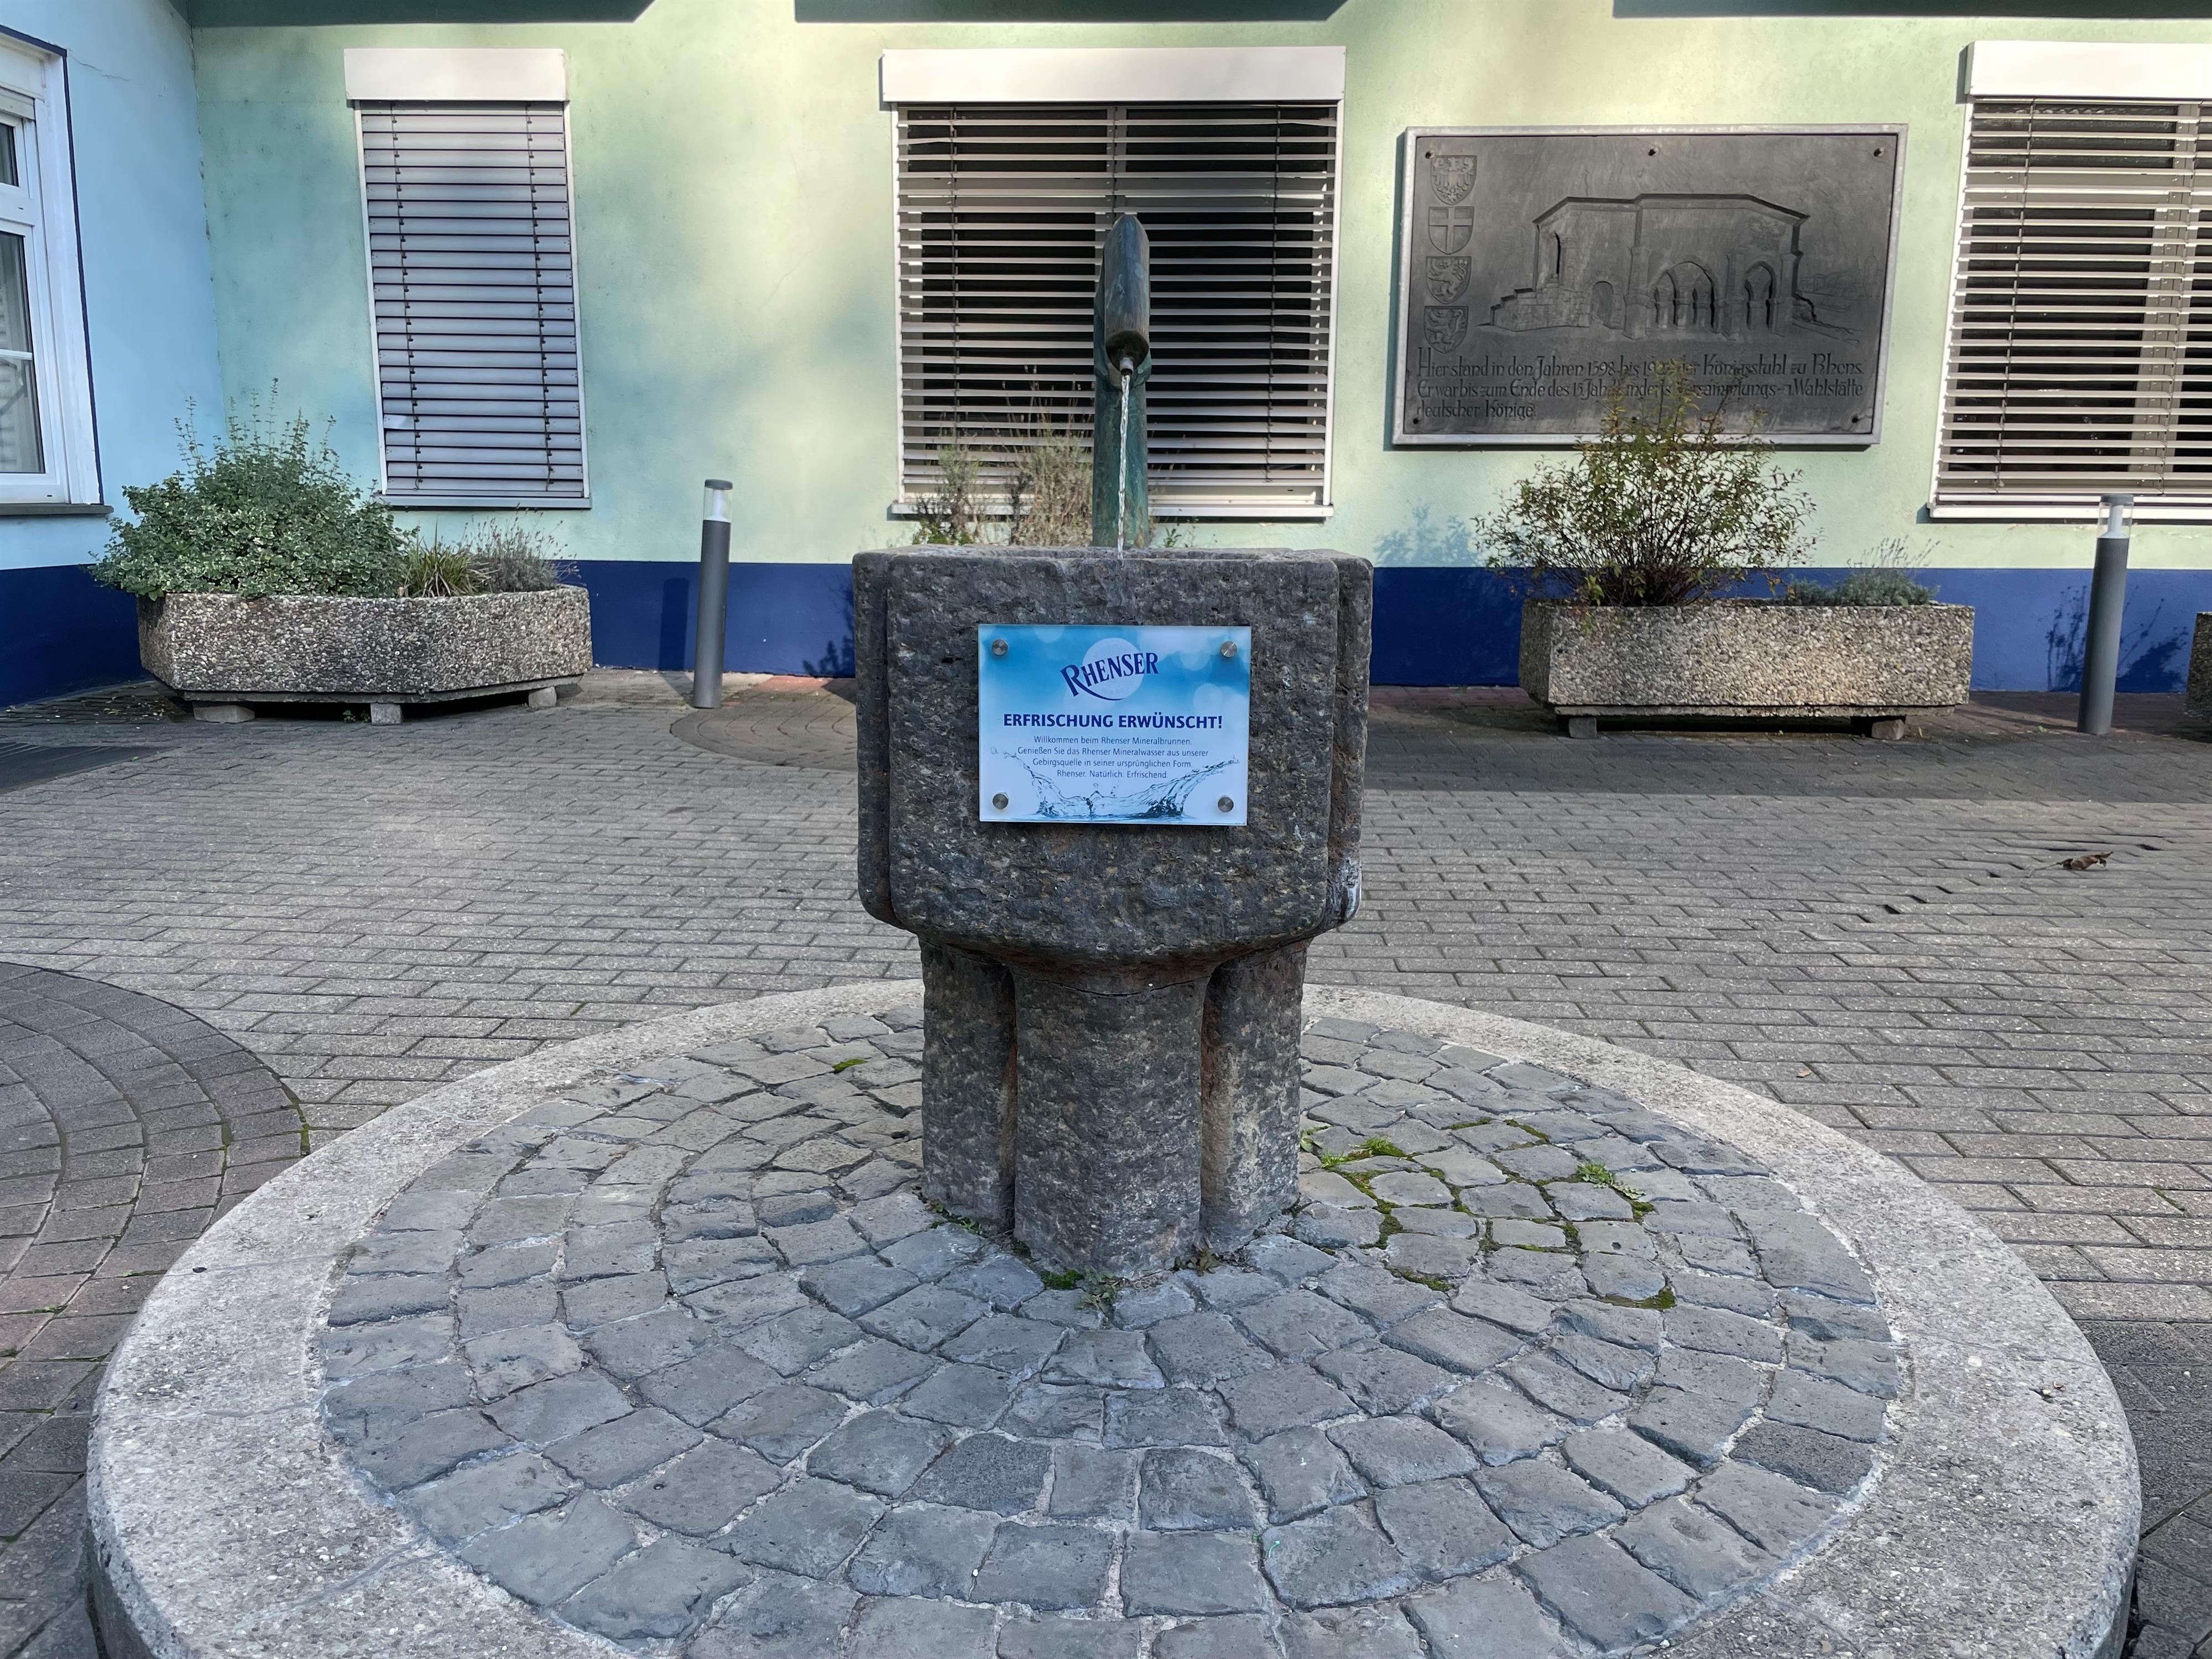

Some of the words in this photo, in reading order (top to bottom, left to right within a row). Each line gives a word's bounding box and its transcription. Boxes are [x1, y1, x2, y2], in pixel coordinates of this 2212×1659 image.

[1417, 347, 1449, 377] Hier
[1451, 355, 1489, 377] stand
[1492, 362, 1505, 376] in
[1508, 355, 1533, 376] den
[1532, 355, 1584, 380] Jahren
[1619, 354, 1641, 377] bis
[1791, 362, 1808, 375] zu
[1459, 378, 1479, 397] bis
[1510, 379, 1546, 398] Ende
[1548, 378, 1570, 397] des
[1417, 399, 1480, 418] deutscher
[1004, 713, 1113, 728] ERFRISCHUNG
[1118, 712, 1222, 729] ERWÜNSCHT!
[1034, 735, 1078, 744] Willkommen
[1081, 736, 1099, 744] beim
[1132, 737, 1192, 745] Mineralbrunnen.
[1032, 758, 1082, 768] Gebirgsquelle
[1117, 759, 1171, 769] ursprünglichen
[1057, 769, 1087, 778] Rhenser.
[1089, 770, 1124, 778] Natürlich.
[1126, 770, 1168, 779] Erfrischend.
